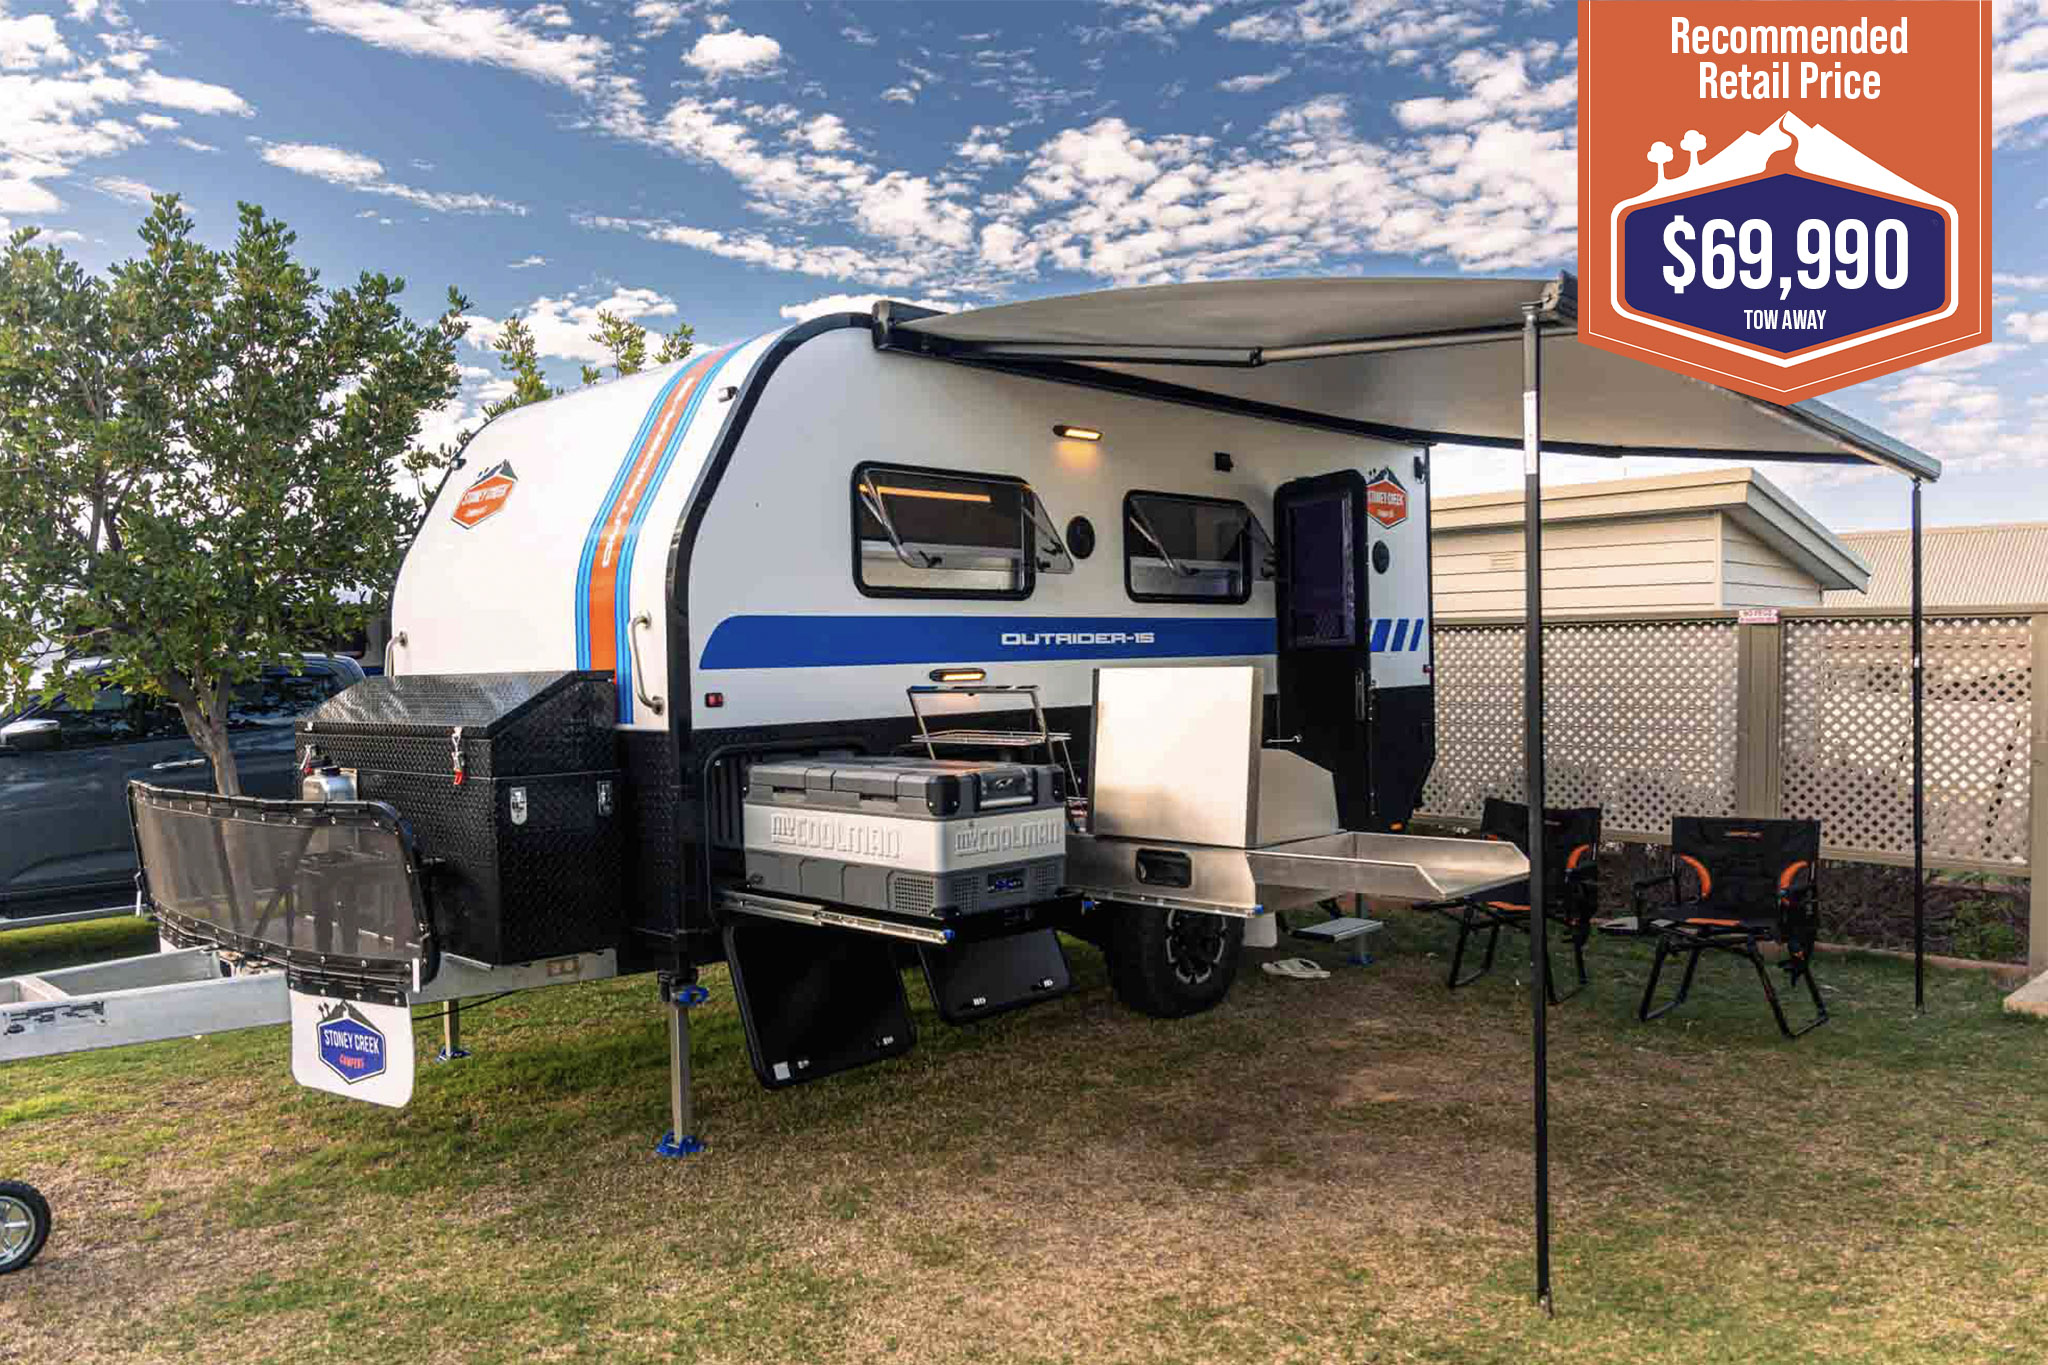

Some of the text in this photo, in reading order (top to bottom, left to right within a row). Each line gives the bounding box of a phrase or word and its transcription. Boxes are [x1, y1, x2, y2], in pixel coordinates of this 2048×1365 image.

[1001, 632, 1155, 646] OUTRIDER-15
[324, 1029, 380, 1054] STONEY CREEK
